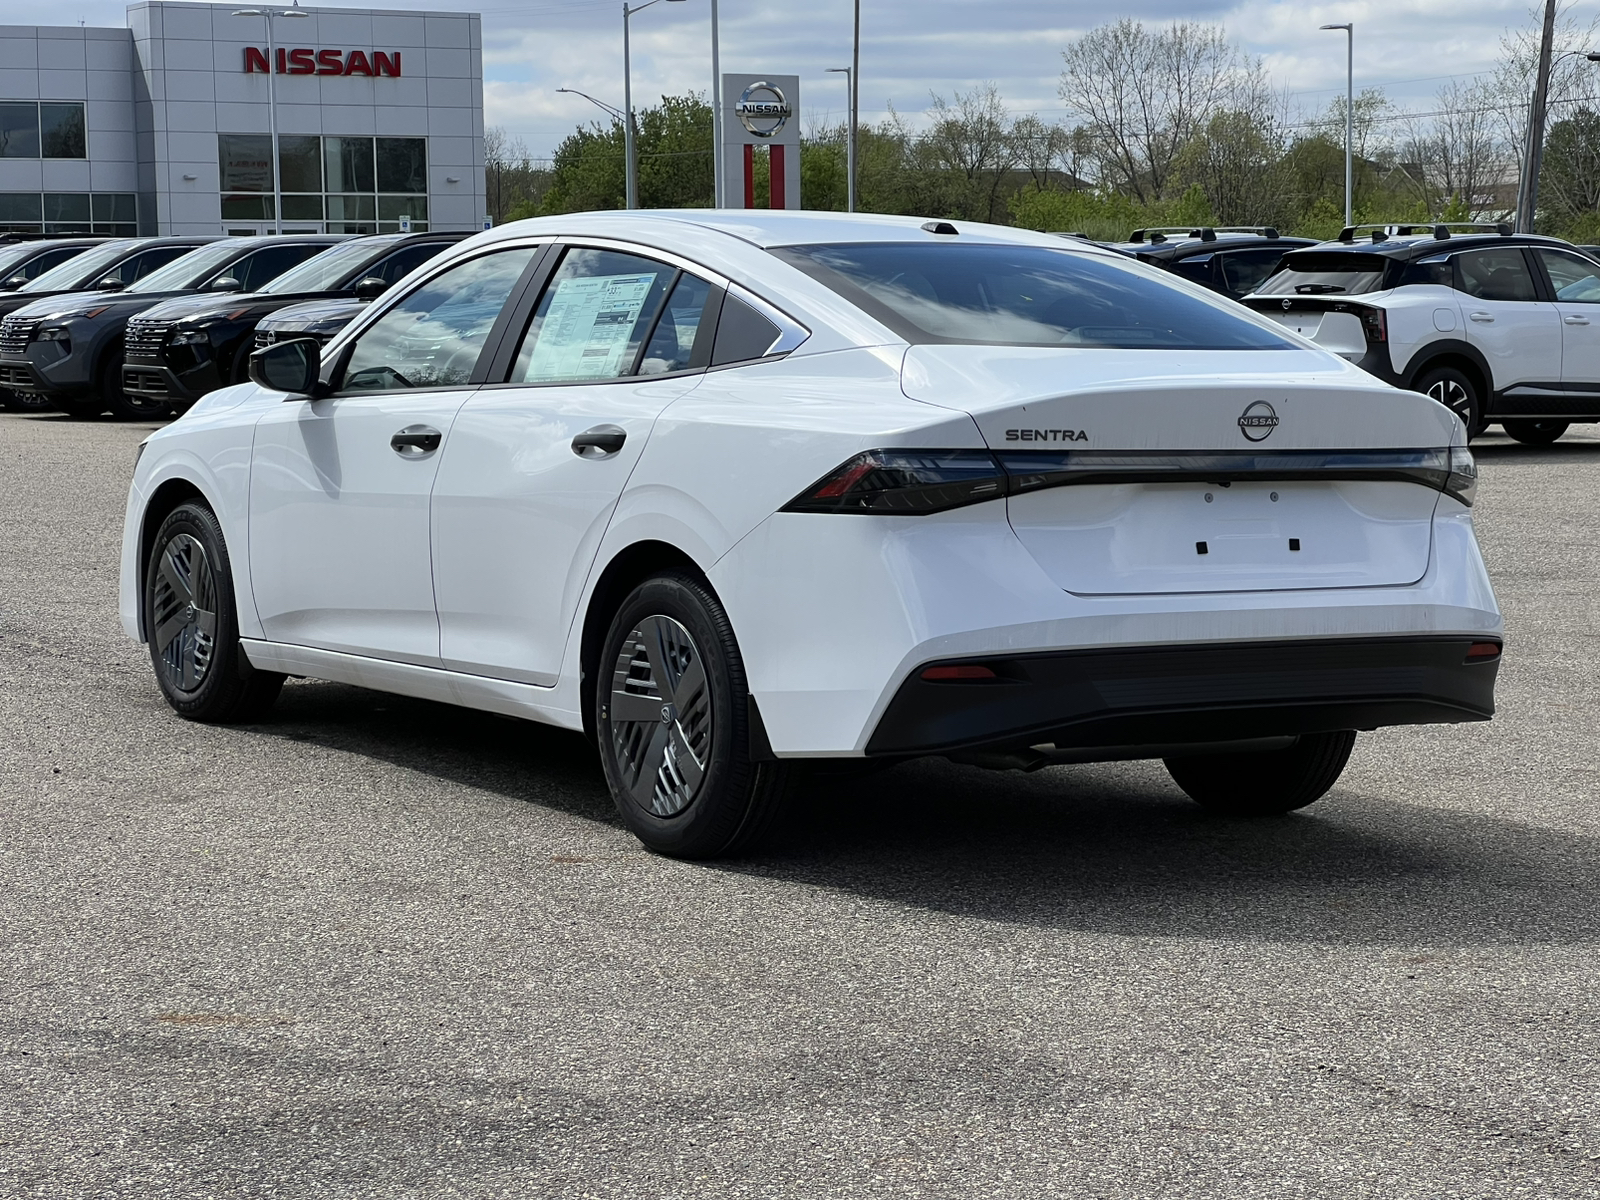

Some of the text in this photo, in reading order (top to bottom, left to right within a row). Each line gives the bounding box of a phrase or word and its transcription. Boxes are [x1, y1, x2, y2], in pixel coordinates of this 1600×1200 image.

[245, 47, 402, 77] NISSAN
[742, 104, 788, 114] NISSAN
[1240, 418, 1279, 426] NISSAN
[1005, 429, 1089, 442] SENTRA
